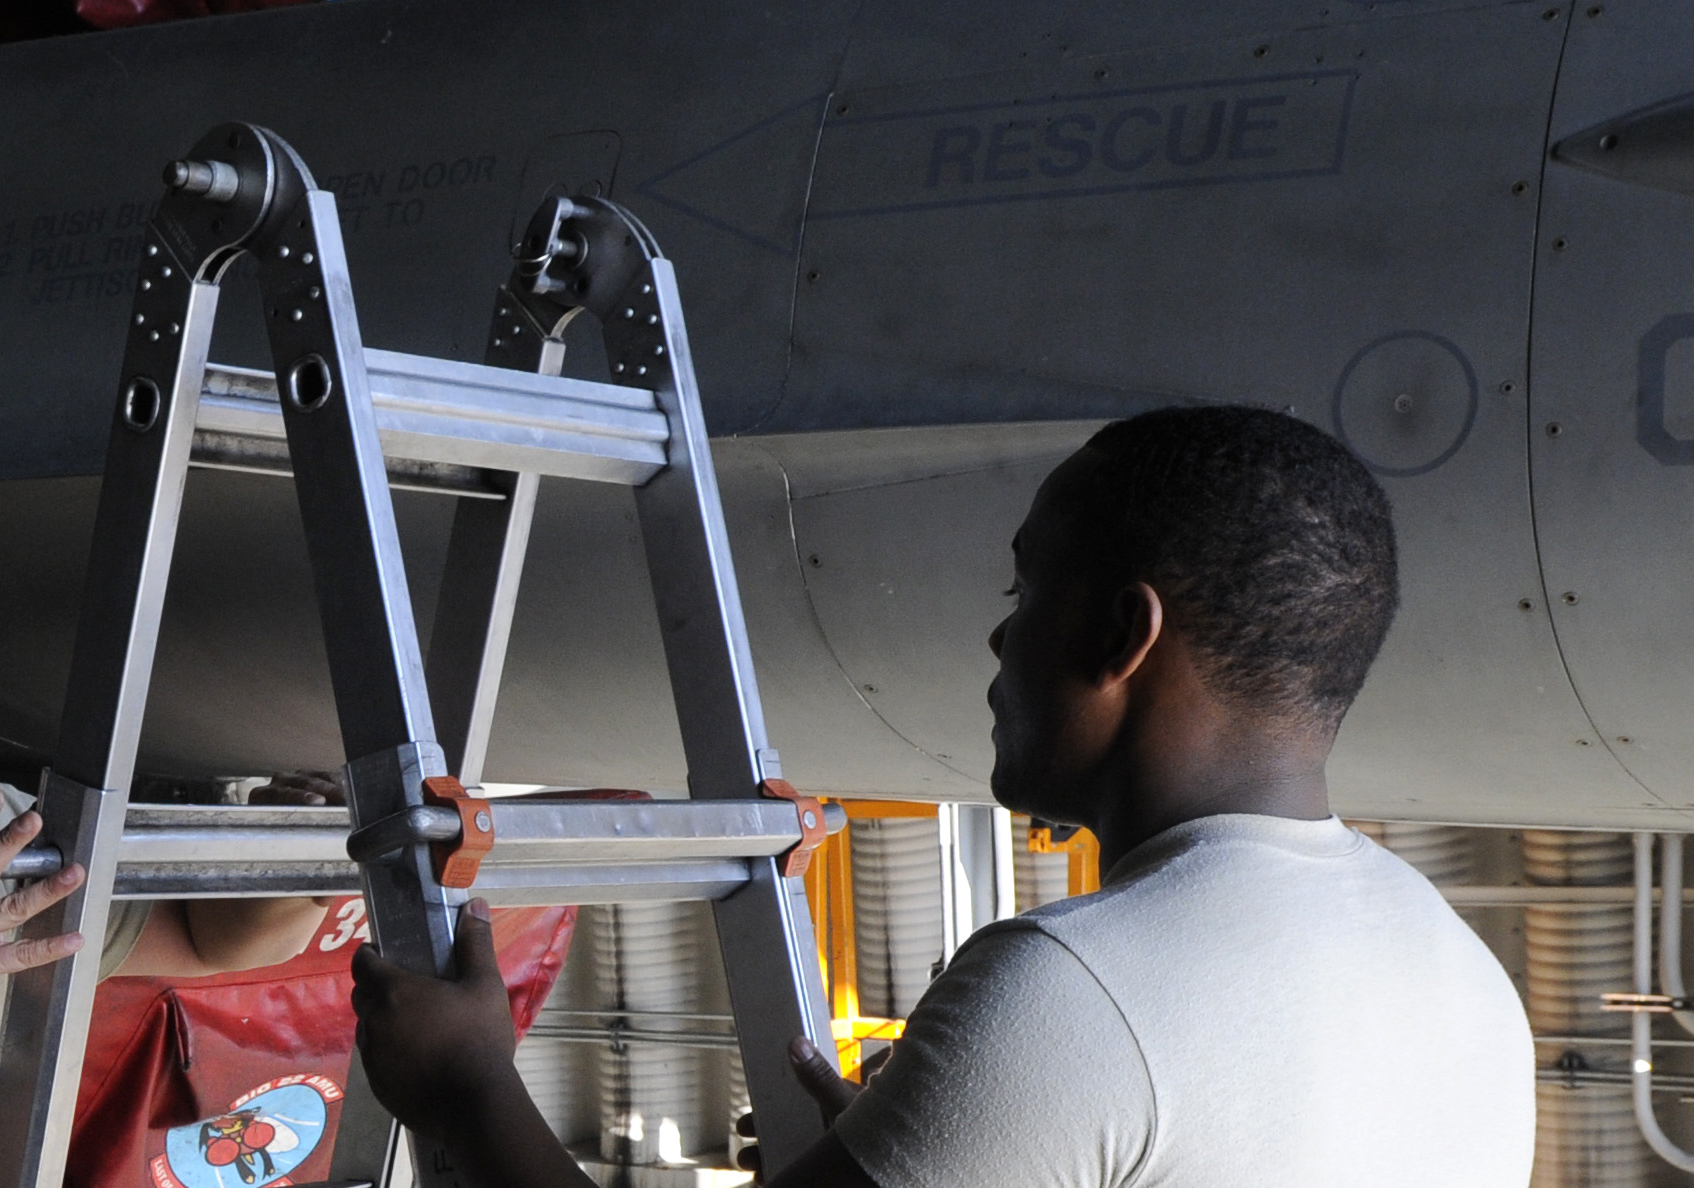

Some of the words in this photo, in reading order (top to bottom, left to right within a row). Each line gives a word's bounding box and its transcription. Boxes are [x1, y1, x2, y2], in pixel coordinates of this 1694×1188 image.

[922, 95, 1288, 188] RESCUE
[30, 208, 107, 240] PUSH
[316, 169, 386, 199] PEN
[398, 155, 498, 194] DOOR
[384, 197, 425, 229] TO
[277, 1074, 307, 1087] 22
[305, 1073, 341, 1100] AMU
[154, 1159, 167, 1181] LAST
